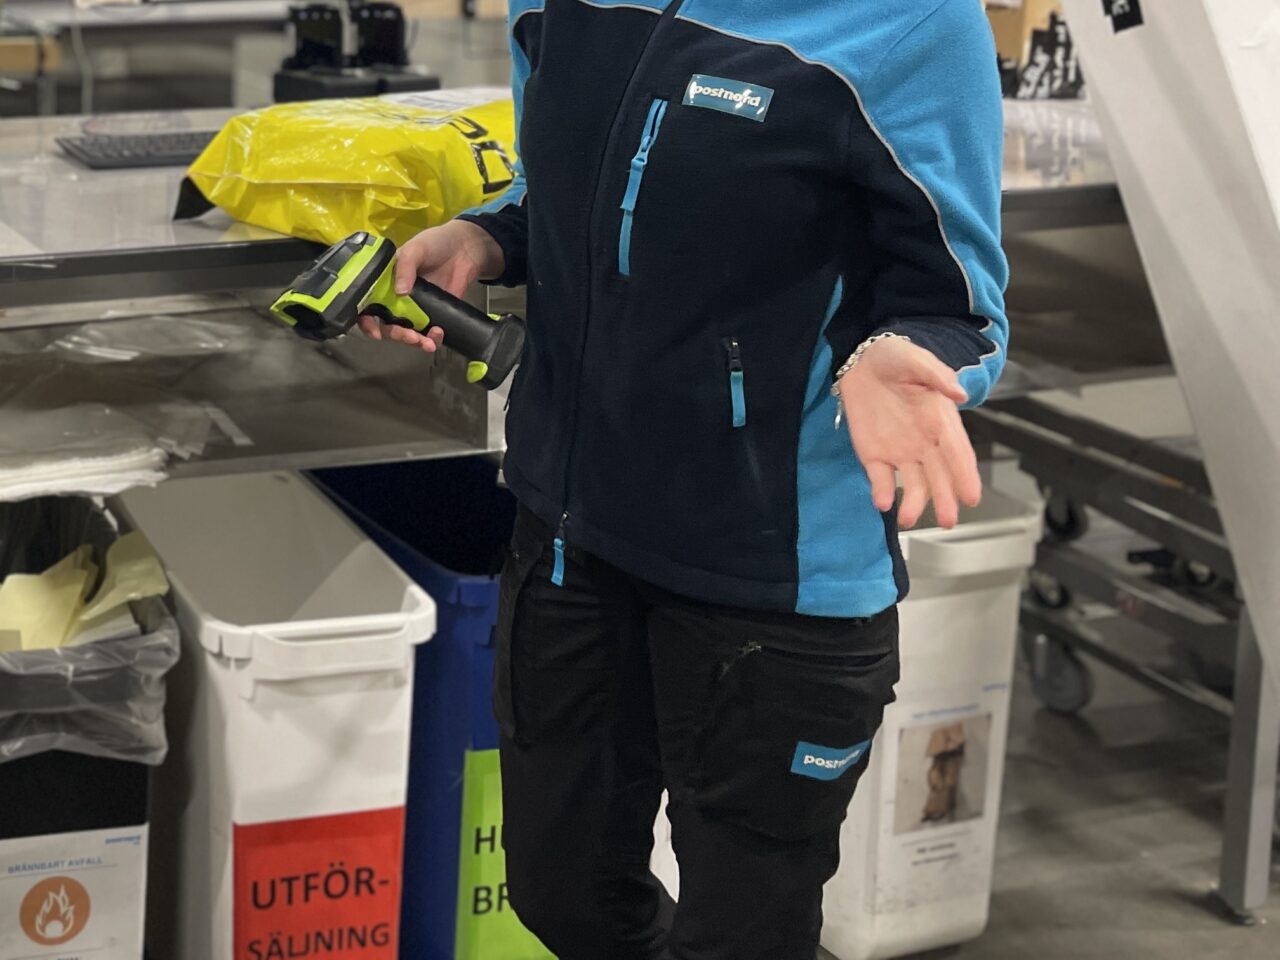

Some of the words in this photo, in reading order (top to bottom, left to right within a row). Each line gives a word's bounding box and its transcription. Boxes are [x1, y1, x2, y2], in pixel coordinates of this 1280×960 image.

[7, 858, 65, 875] BRÄNNBART
[68, 856, 103, 868] AVFALL
[251, 861, 390, 910] UTFÖR-
[247, 922, 391, 960] SÄLJNING
